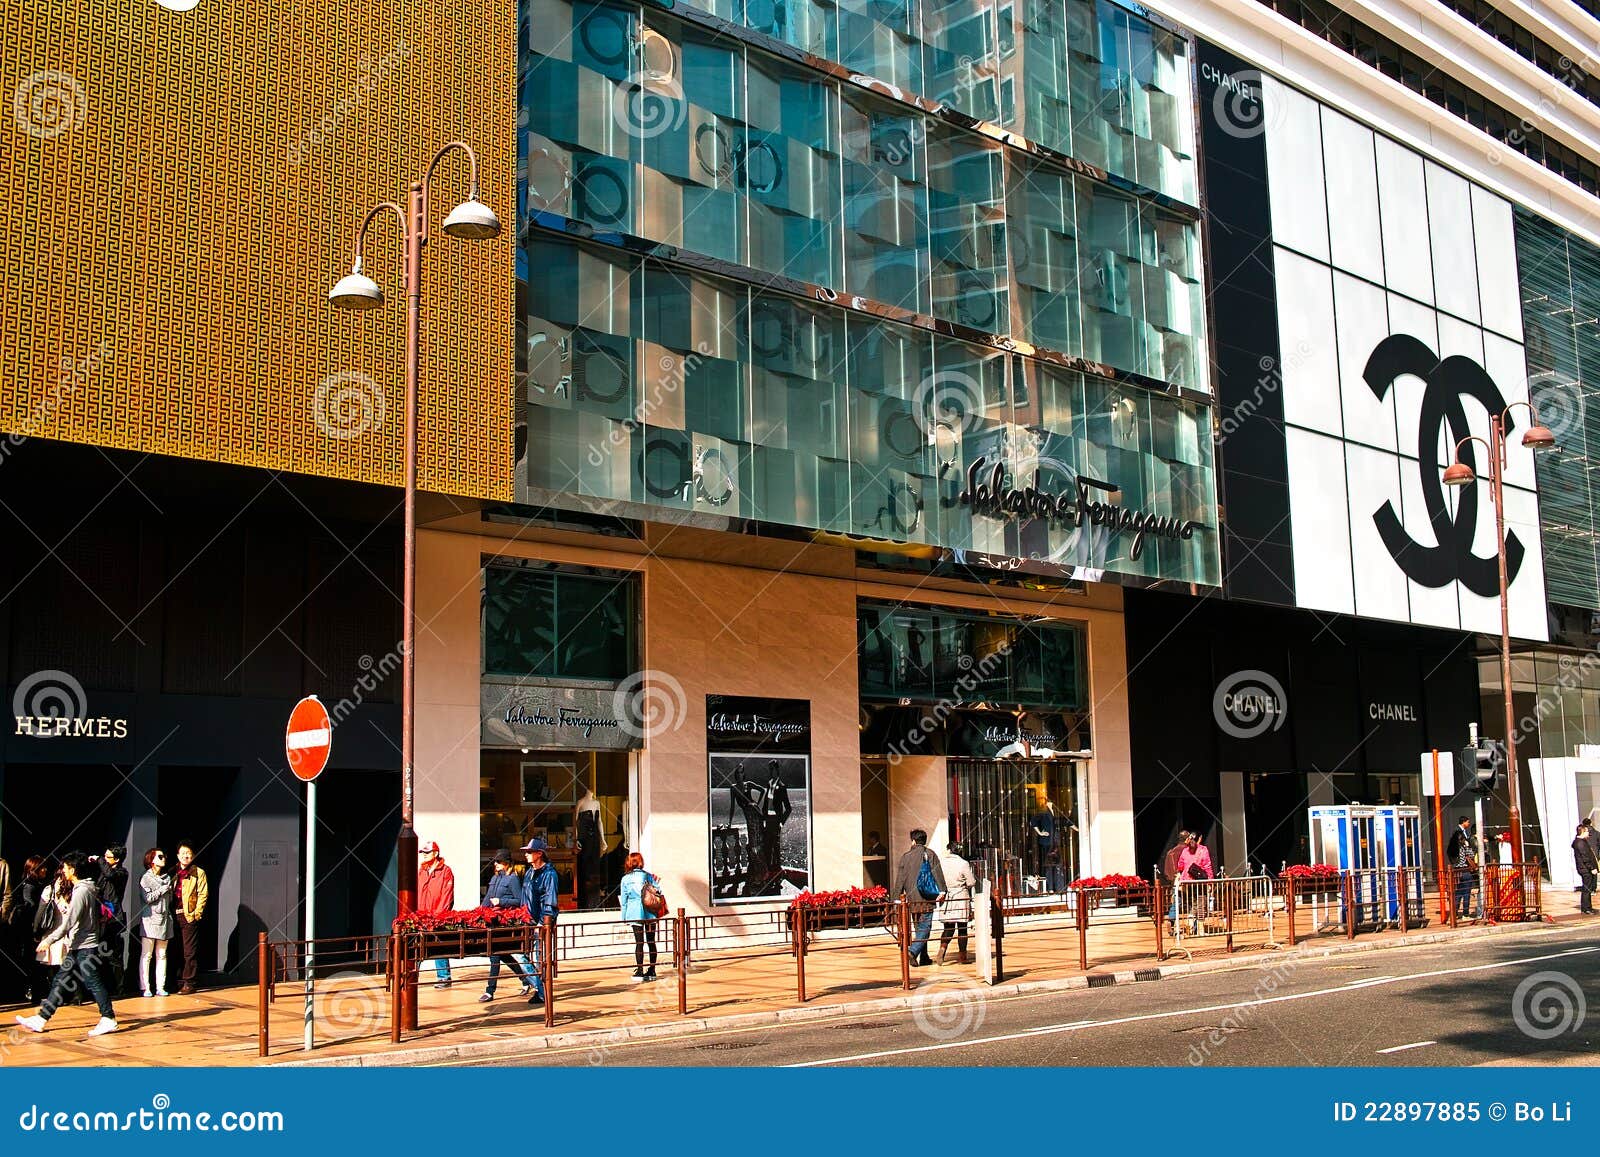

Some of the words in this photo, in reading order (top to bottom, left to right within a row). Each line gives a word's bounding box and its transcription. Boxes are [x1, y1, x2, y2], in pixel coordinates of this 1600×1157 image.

[1201, 62, 1258, 104] CHANEL
[959, 456, 1074, 521] Salvatore
[1073, 474, 1205, 562] Ferragamo
[1223, 693, 1282, 714] CHANEL
[1369, 703, 1417, 722] CHANEL
[15, 716, 128, 739] HERMÈS
[503, 705, 556, 727] Salvatore
[558, 707, 622, 739] Ferragamo
[707, 712, 753, 732] Salvatore
[752, 714, 807, 743] Ferragamo
